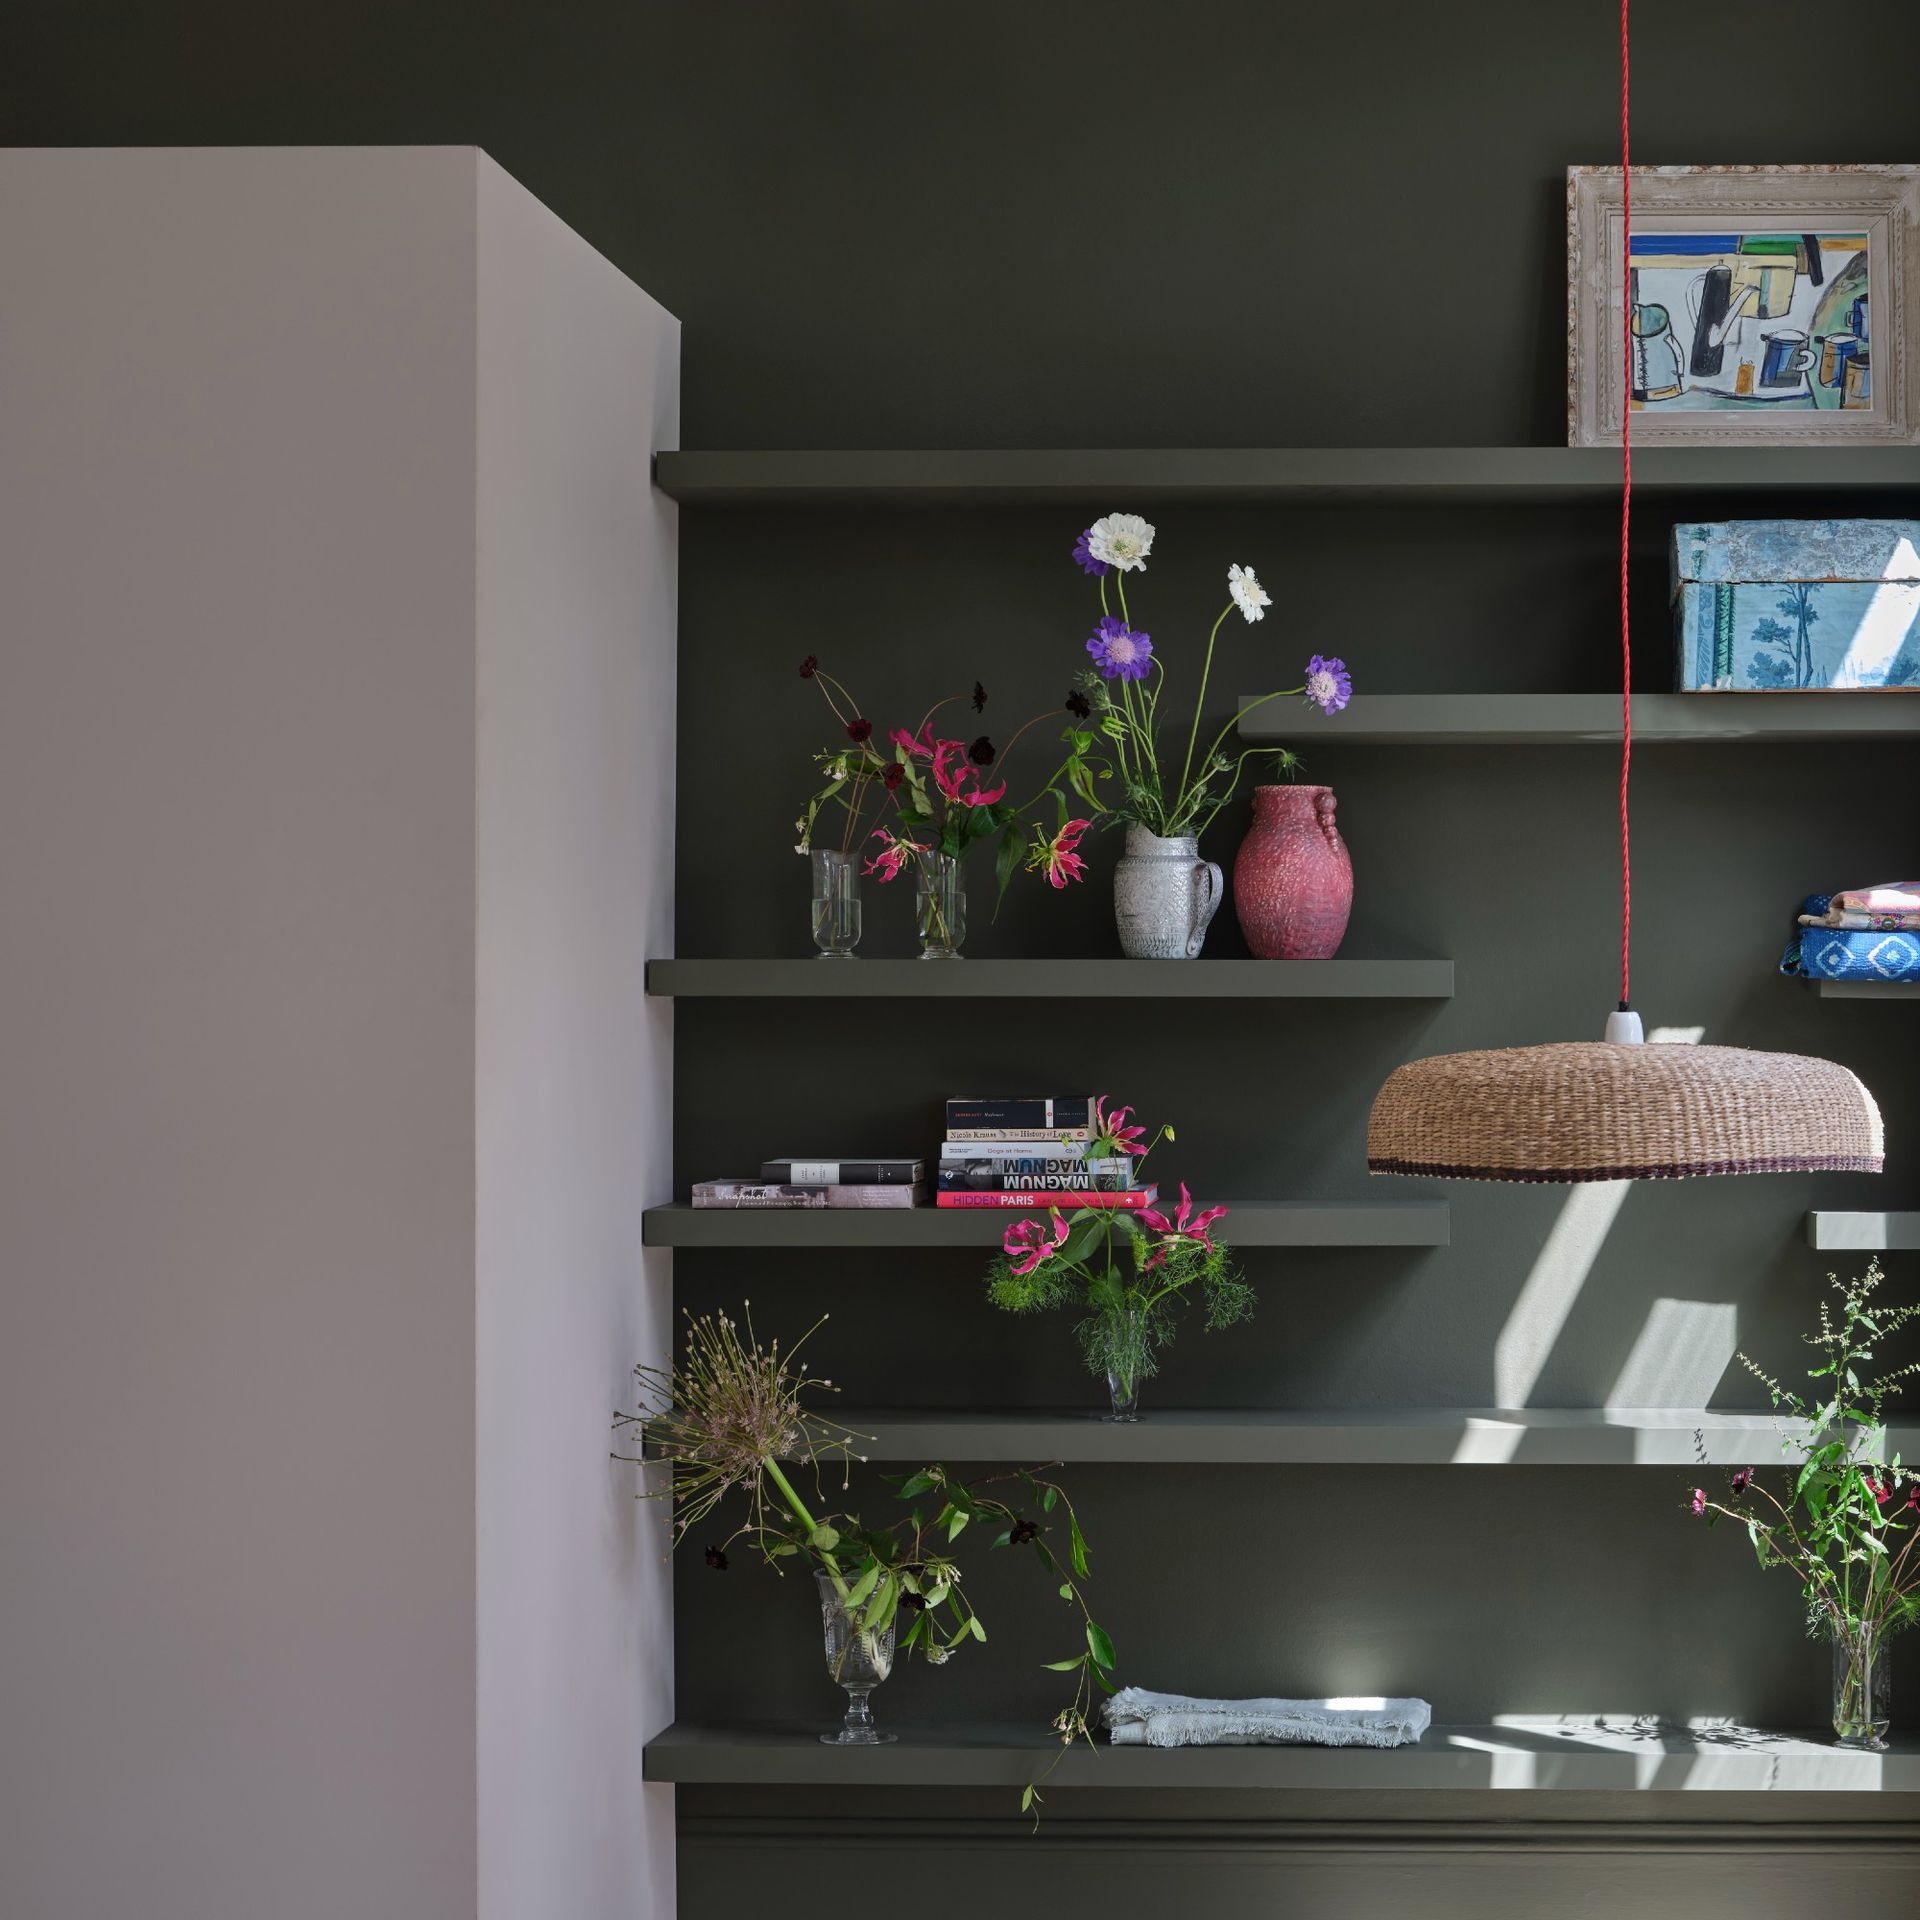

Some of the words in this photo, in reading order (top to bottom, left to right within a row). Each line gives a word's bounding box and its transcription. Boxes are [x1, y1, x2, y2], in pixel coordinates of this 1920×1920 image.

[950, 1131, 972, 1139] Nicole
[973, 1131, 997, 1139] Krauss
[1020, 1130, 1046, 1139] History
[1053, 1130, 1072, 1138] Love
[1003, 1159, 1088, 1173] MAGNUM
[1003, 1175, 1089, 1189] MAGNUM
[953, 1195, 1000, 1205] HIDDEN
[1001, 1195, 1034, 1205] PARIS
